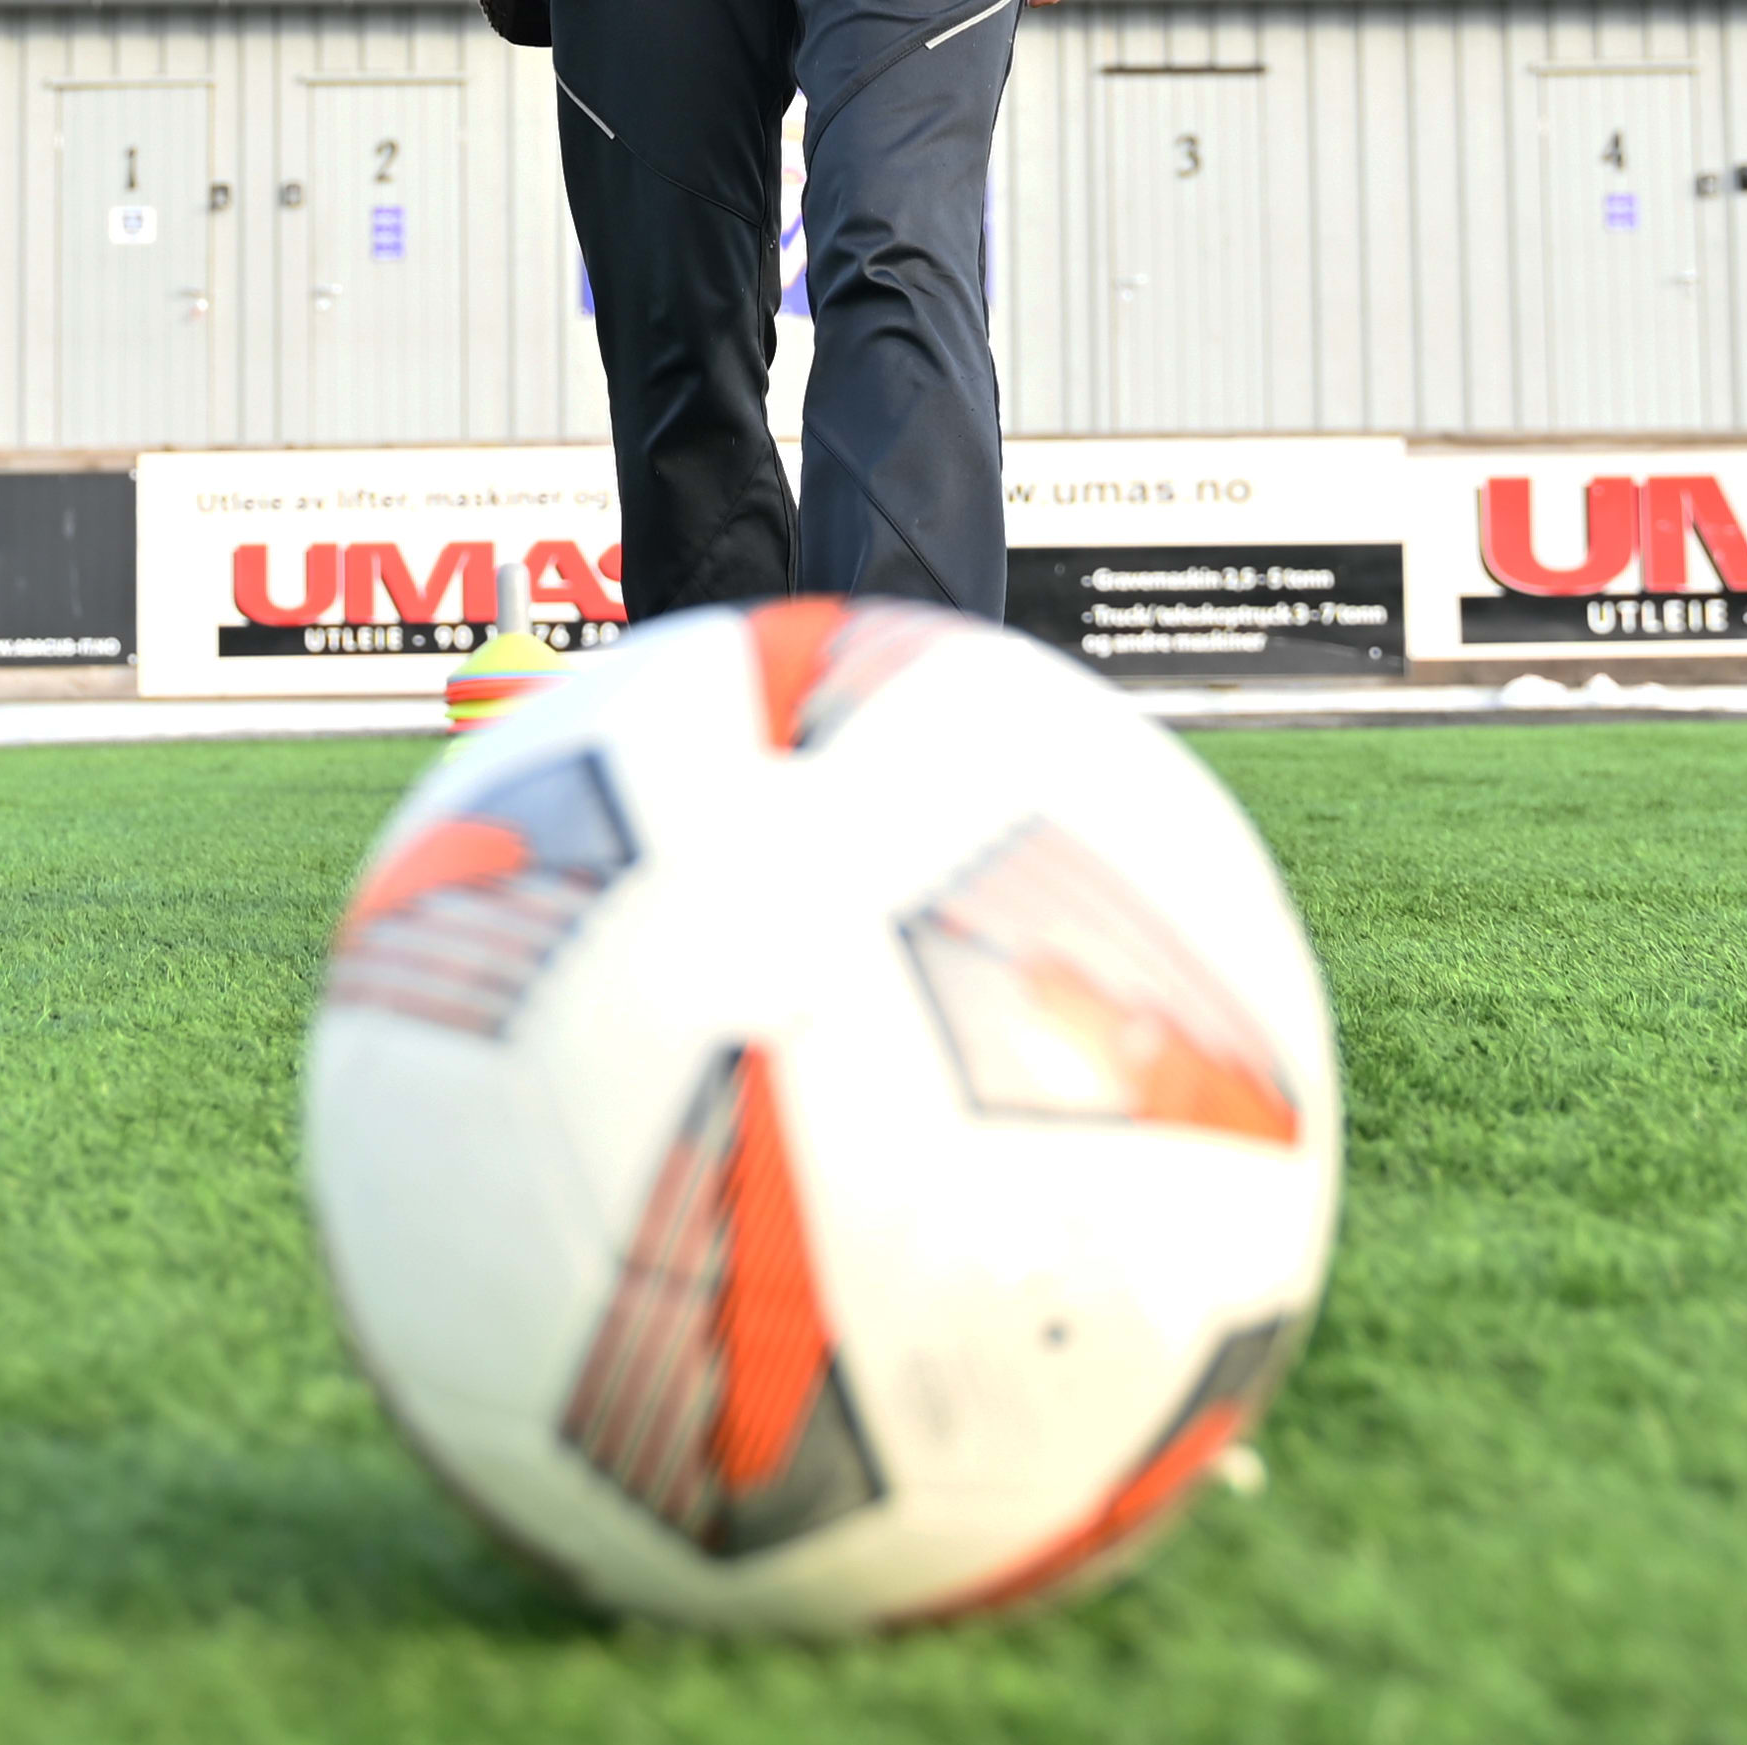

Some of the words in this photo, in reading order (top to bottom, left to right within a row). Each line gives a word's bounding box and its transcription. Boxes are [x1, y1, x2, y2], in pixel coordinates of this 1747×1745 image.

[123, 145, 140, 192] 1
[373, 139, 399, 184] 2
[1175, 134, 1202, 179] 3
[1600, 129, 1627, 170] 4
[233, 540, 623, 627] UMA
[304, 626, 404, 654] UTLEIE
[434, 624, 474, 650] 90
[532, 623, 570, 649] 76
[581, 622, 621, 648] 50
[1586, 598, 1729, 634] UTLEIE
